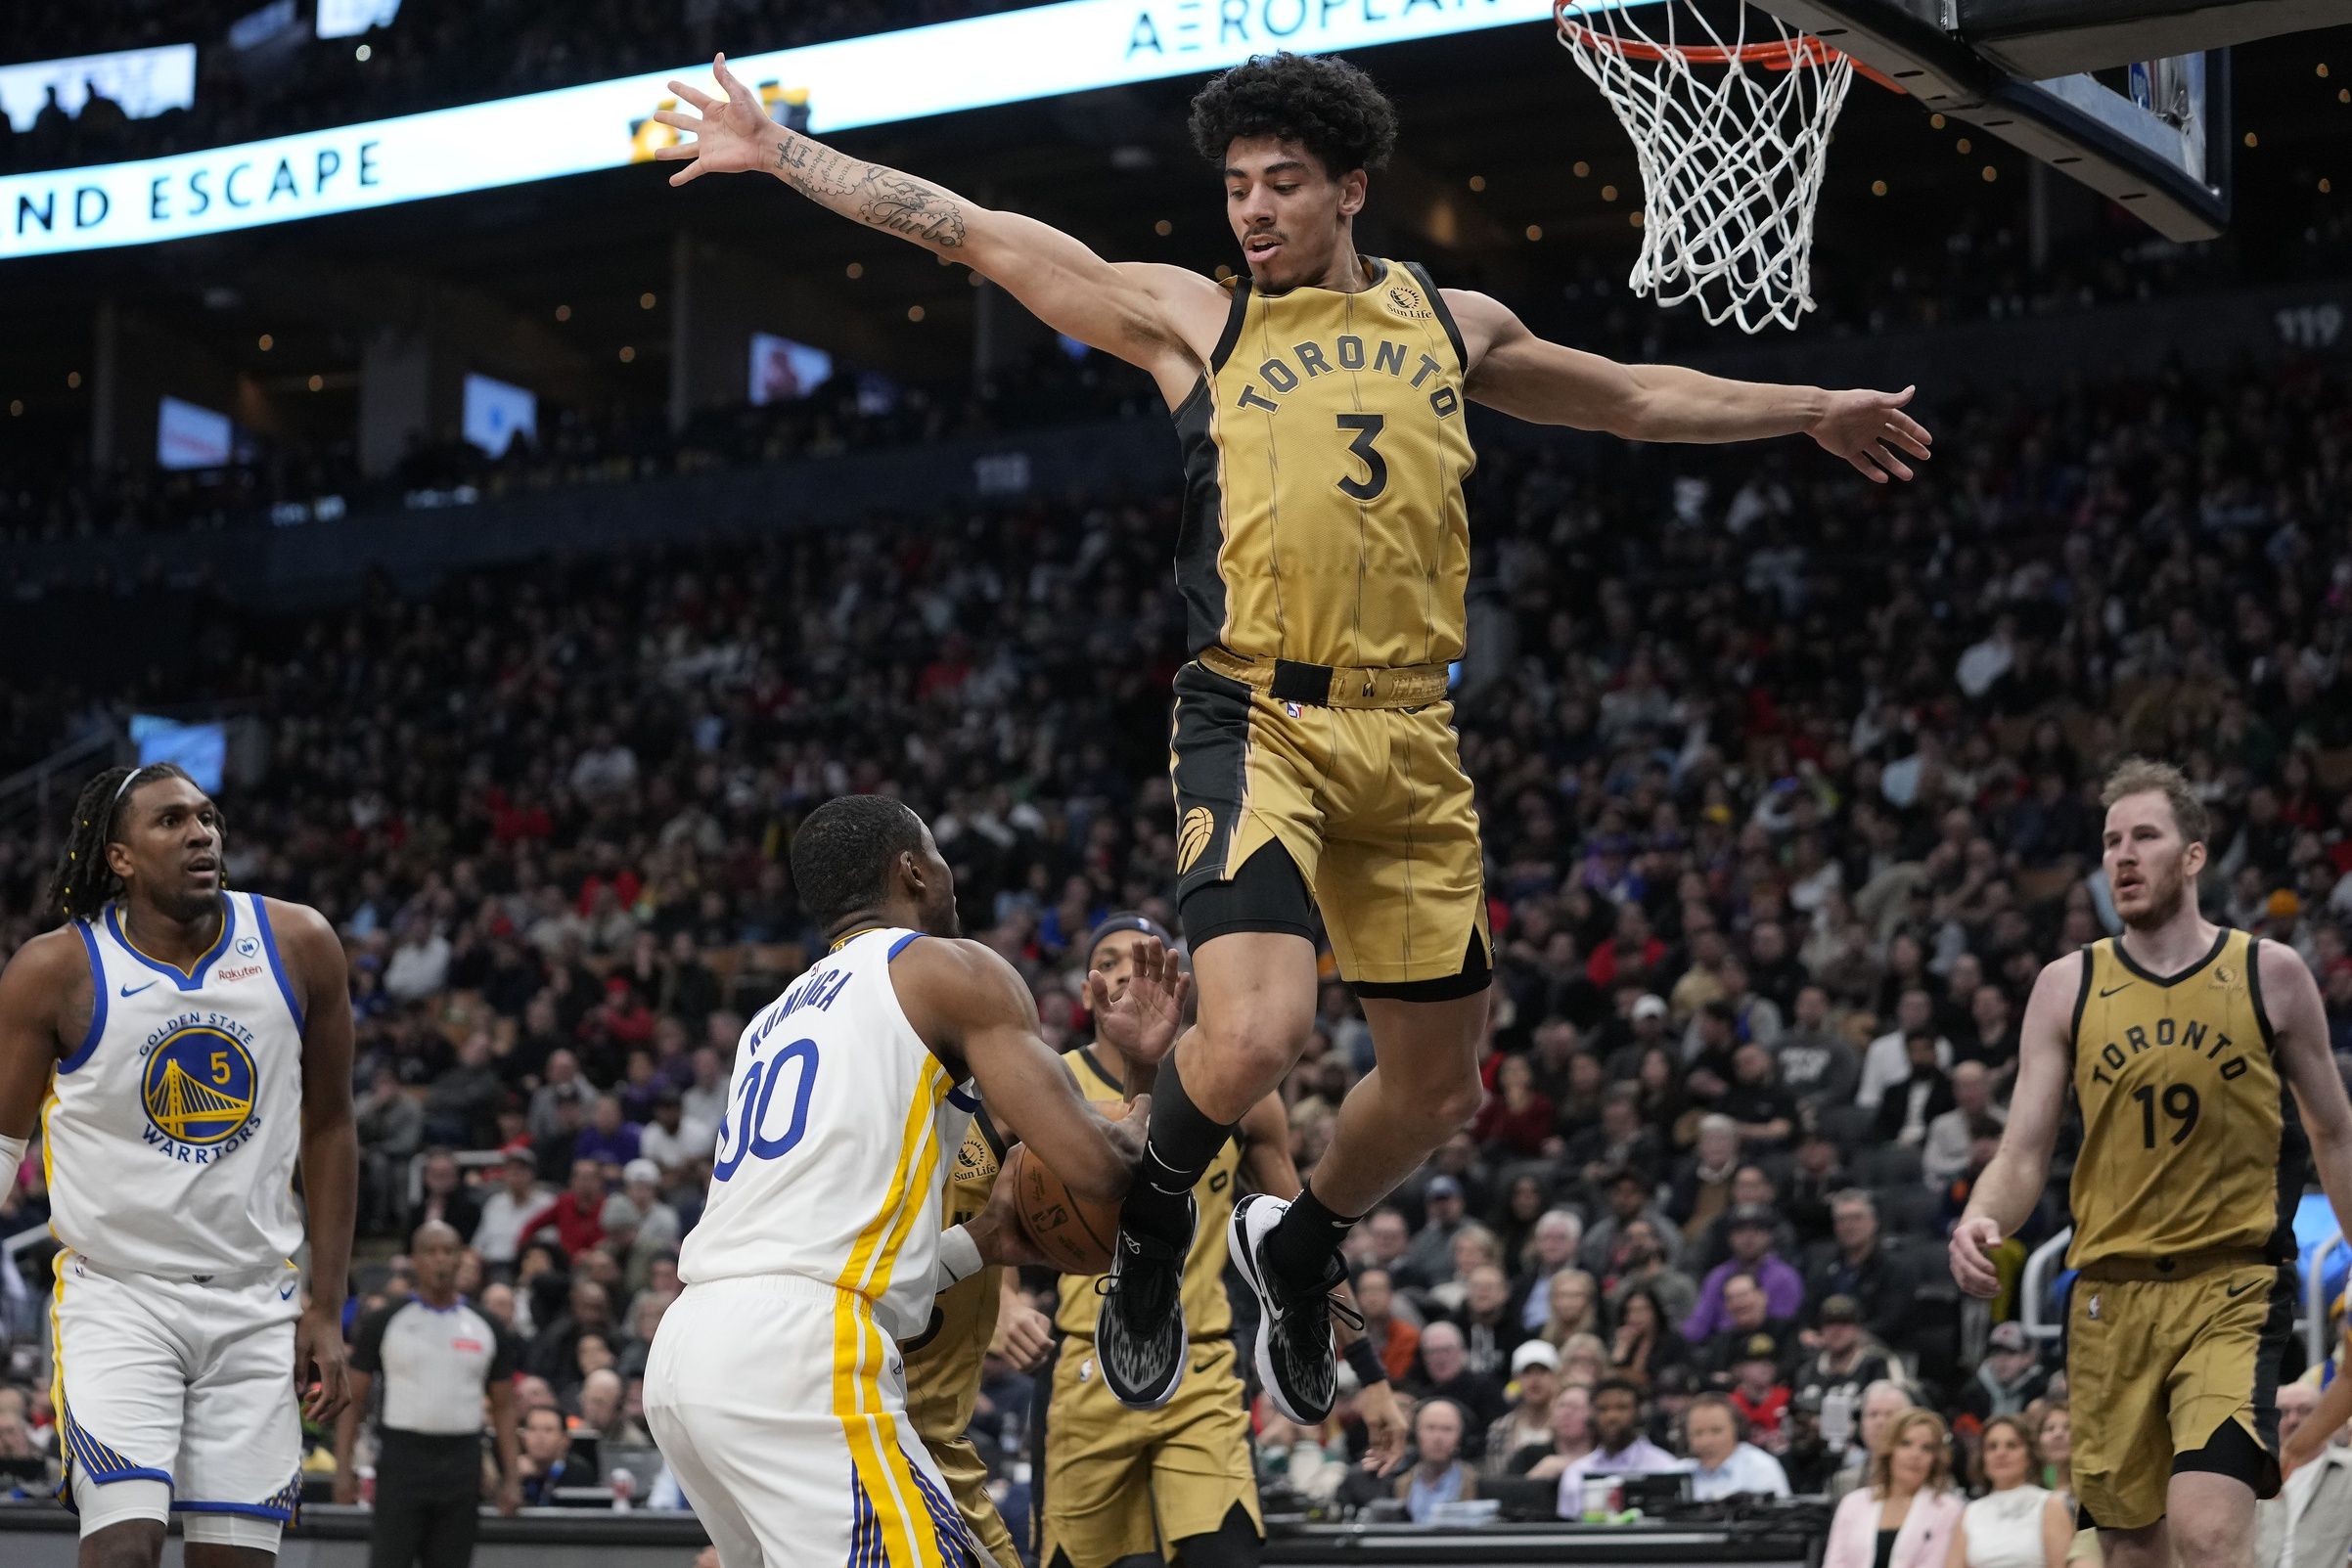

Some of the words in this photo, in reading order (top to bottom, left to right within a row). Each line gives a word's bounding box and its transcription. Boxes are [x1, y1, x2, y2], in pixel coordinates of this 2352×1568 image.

[1125, 0, 1495, 59] AEROPL
[17, 187, 109, 235] ND
[150, 141, 381, 220] ESCAPE
[865, 201, 956, 246] Turbo
[1387, 303, 1407, 317] Sun
[1410, 309, 1431, 319] Life
[1236, 334, 1459, 420] TORONTO
[1334, 413, 1388, 502] 3
[218, 965, 262, 981] Rakuten
[139, 1011, 201, 1056] GOLDEN
[208, 1012, 254, 1046] STATE
[2092, 1017, 2247, 1087] TORONTO
[210, 1051, 232, 1085] 5
[713, 1038, 820, 1182] 00
[2133, 1082, 2199, 1149] 19
[954, 1169, 975, 1182] Sun
[976, 1163, 997, 1178] Life
